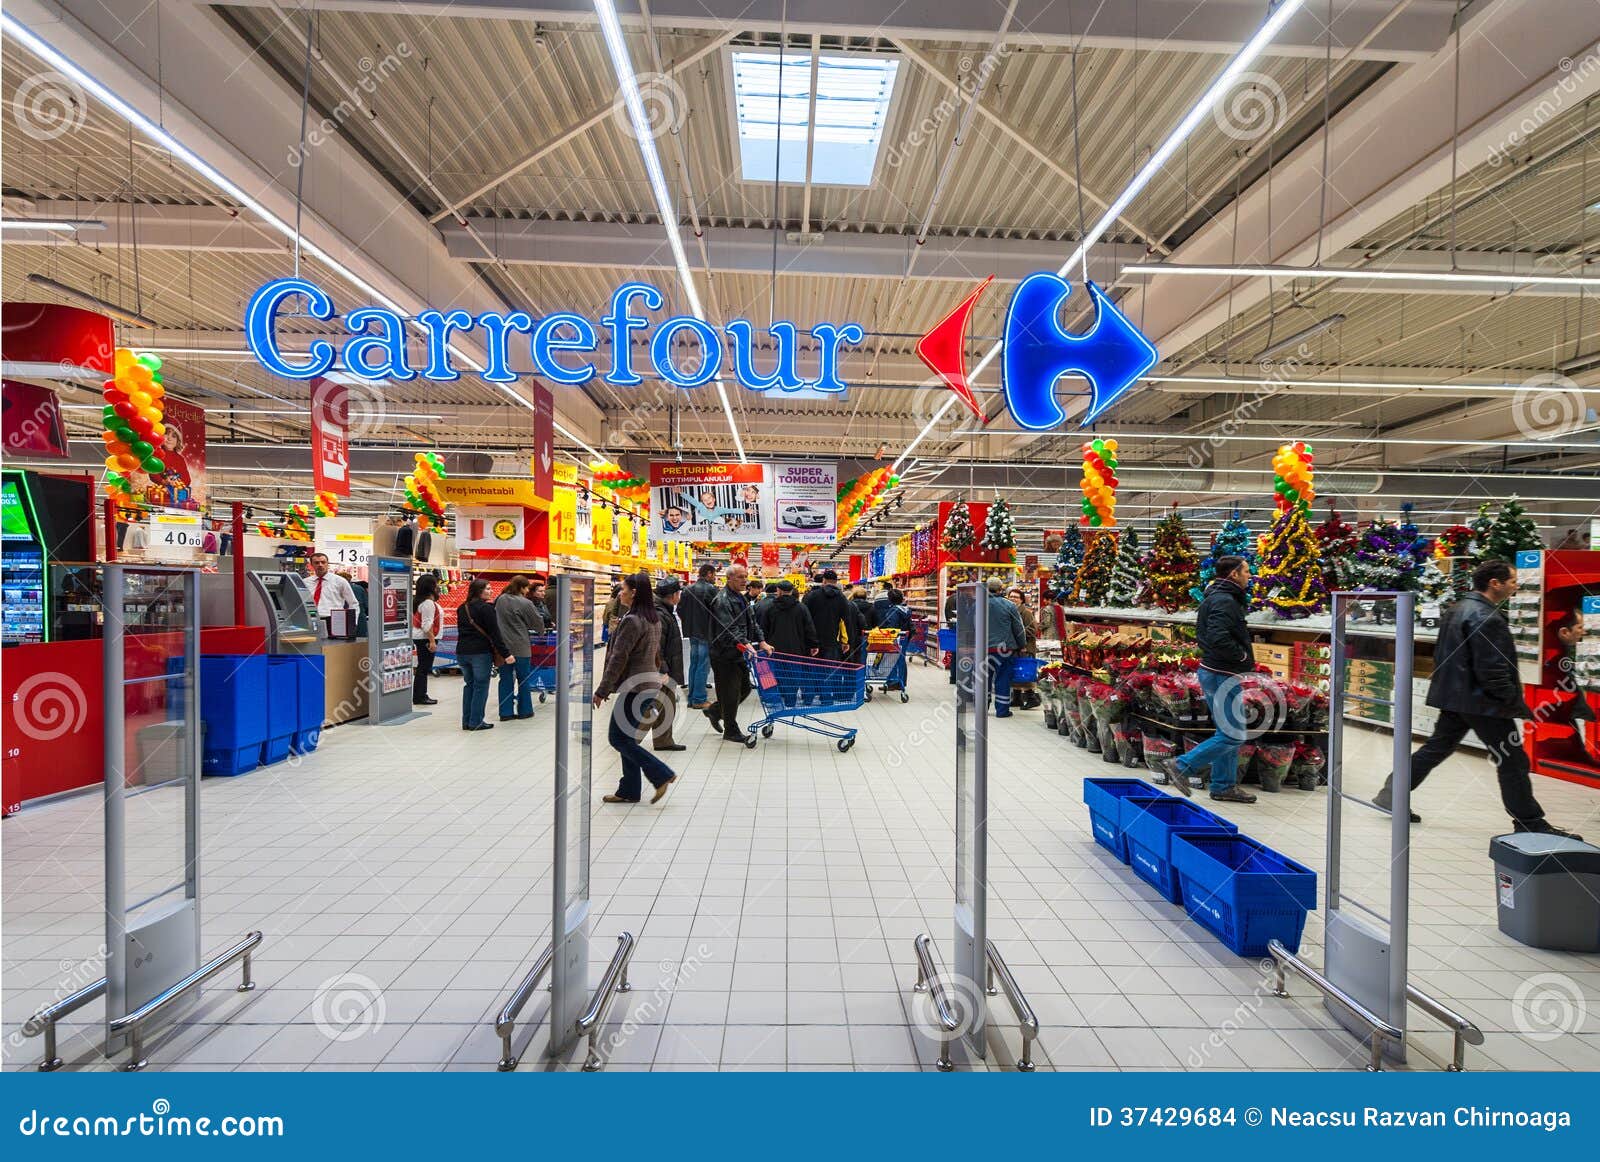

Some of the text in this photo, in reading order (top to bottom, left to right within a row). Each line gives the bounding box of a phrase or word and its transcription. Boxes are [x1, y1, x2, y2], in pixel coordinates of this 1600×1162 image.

[244, 276, 864, 391] Carrefour
[788, 467, 823, 475] SUPER
[778, 474, 834, 484] TOMBOLĂ!
[468, 487, 514, 495] imbatabil
[552, 511, 562, 540] 1
[563, 527, 575, 542] 15
[165, 531, 201, 546] 40 00
[338, 549, 358, 562] 13
[13, 693, 19, 701] 5
[8, 748, 20, 757] 10
[9, 803, 20, 813] 15
